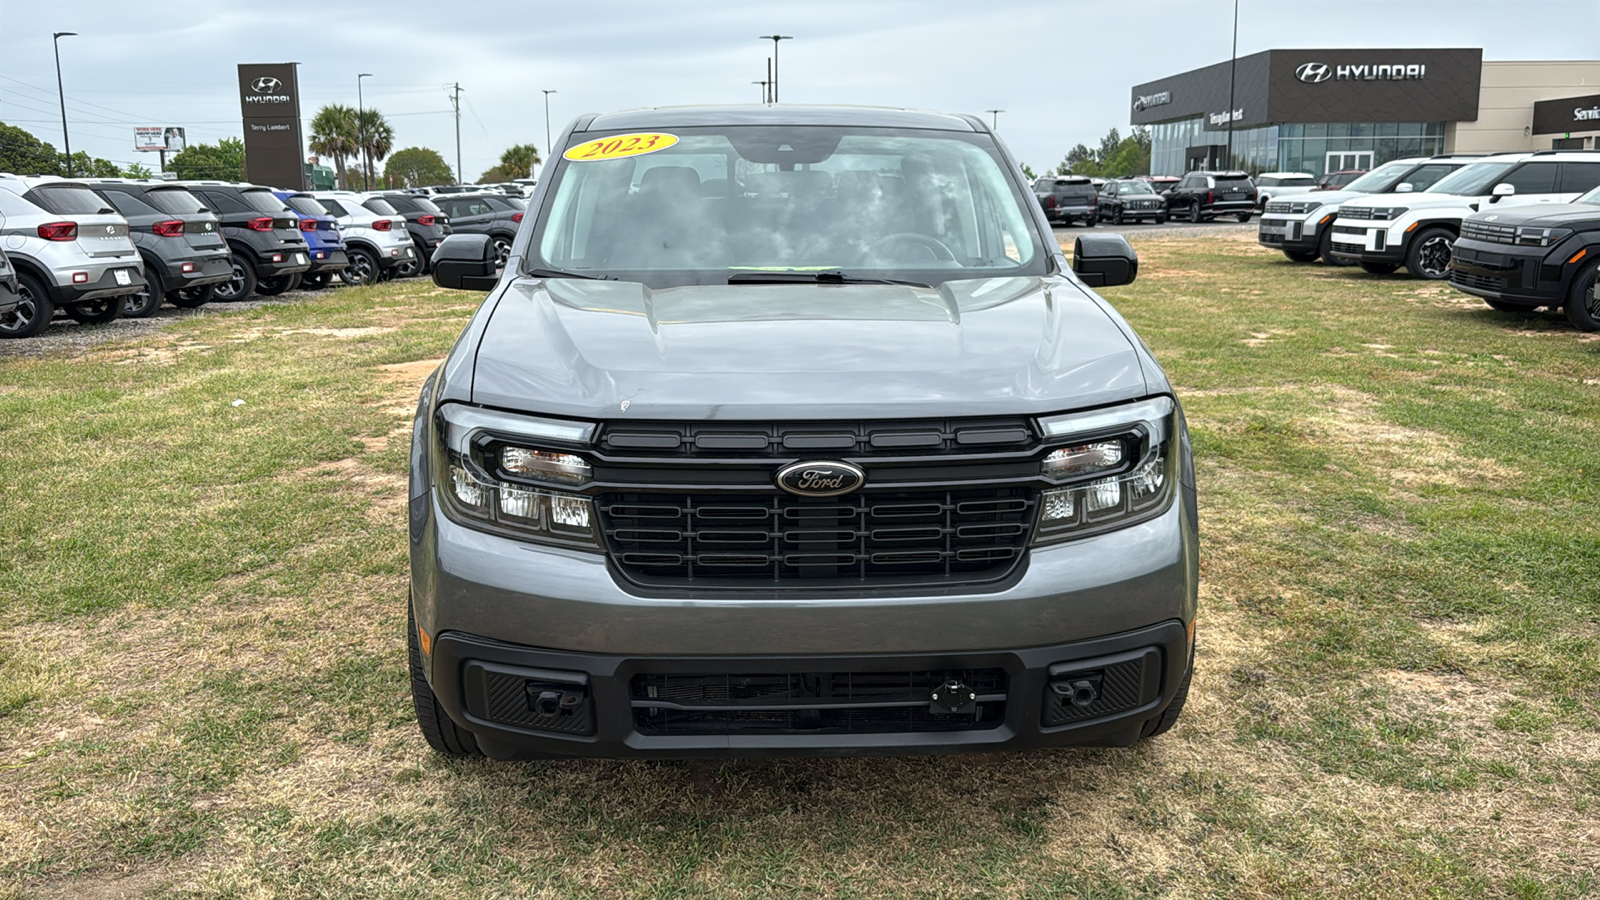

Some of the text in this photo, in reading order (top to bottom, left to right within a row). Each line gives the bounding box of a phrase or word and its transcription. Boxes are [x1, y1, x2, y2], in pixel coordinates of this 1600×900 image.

[1336, 64, 1426, 80] HYUNDAI
[245, 95, 290, 104] HYUNDAI
[251, 124, 266, 132] Terry
[580, 135, 661, 159] 2023
[797, 469, 844, 489] Ford
